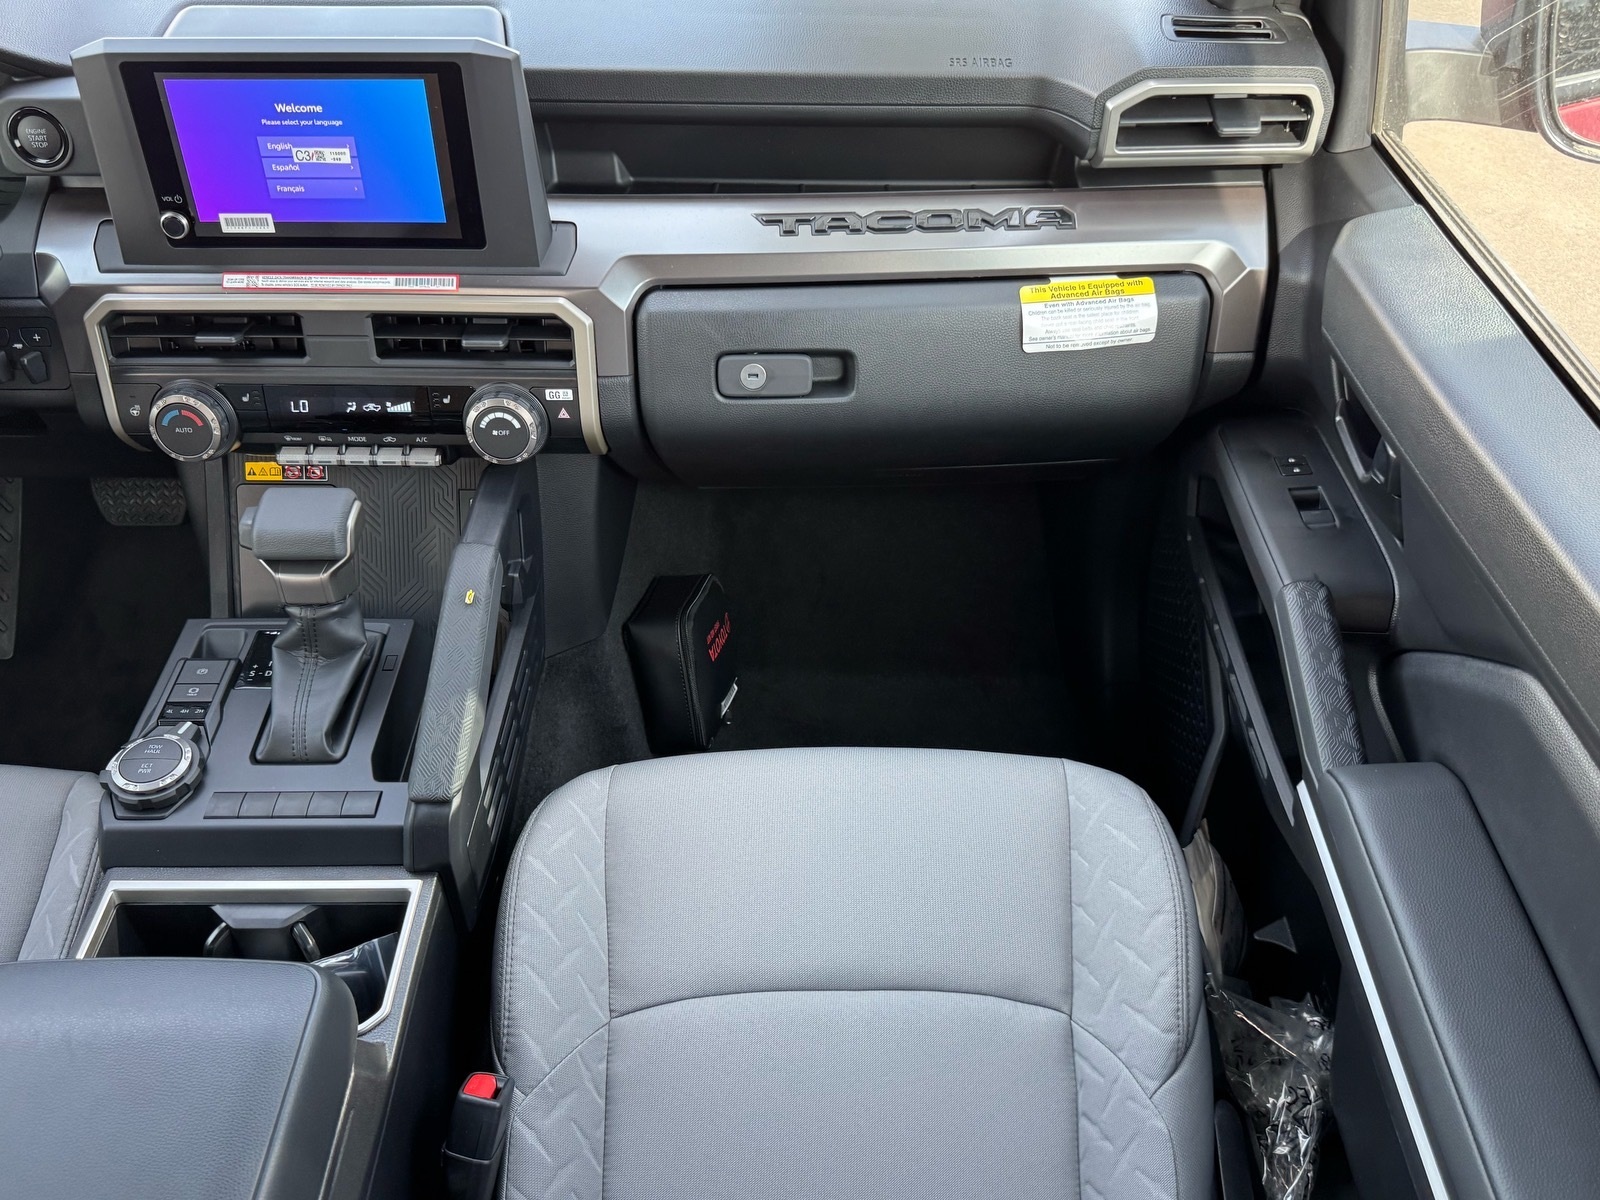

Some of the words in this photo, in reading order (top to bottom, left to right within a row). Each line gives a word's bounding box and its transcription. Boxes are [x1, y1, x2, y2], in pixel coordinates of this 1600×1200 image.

[949, 57, 968, 67] SRS
[972, 57, 1013, 68] AIRBAG
[274, 103, 323, 113] Welcome
[314, 119, 343, 127] language
[267, 142, 293, 152] English
[272, 163, 300, 172] Español
[276, 185, 305, 193] Français
[750, 204, 1078, 237] TACOMA
[1087, 282, 1125, 290] Equipped
[1050, 291, 1090, 300] Advanced
[548, 391, 562, 400] GG
[175, 426, 193, 434] AUTO
[498, 429, 510, 437] OFF
